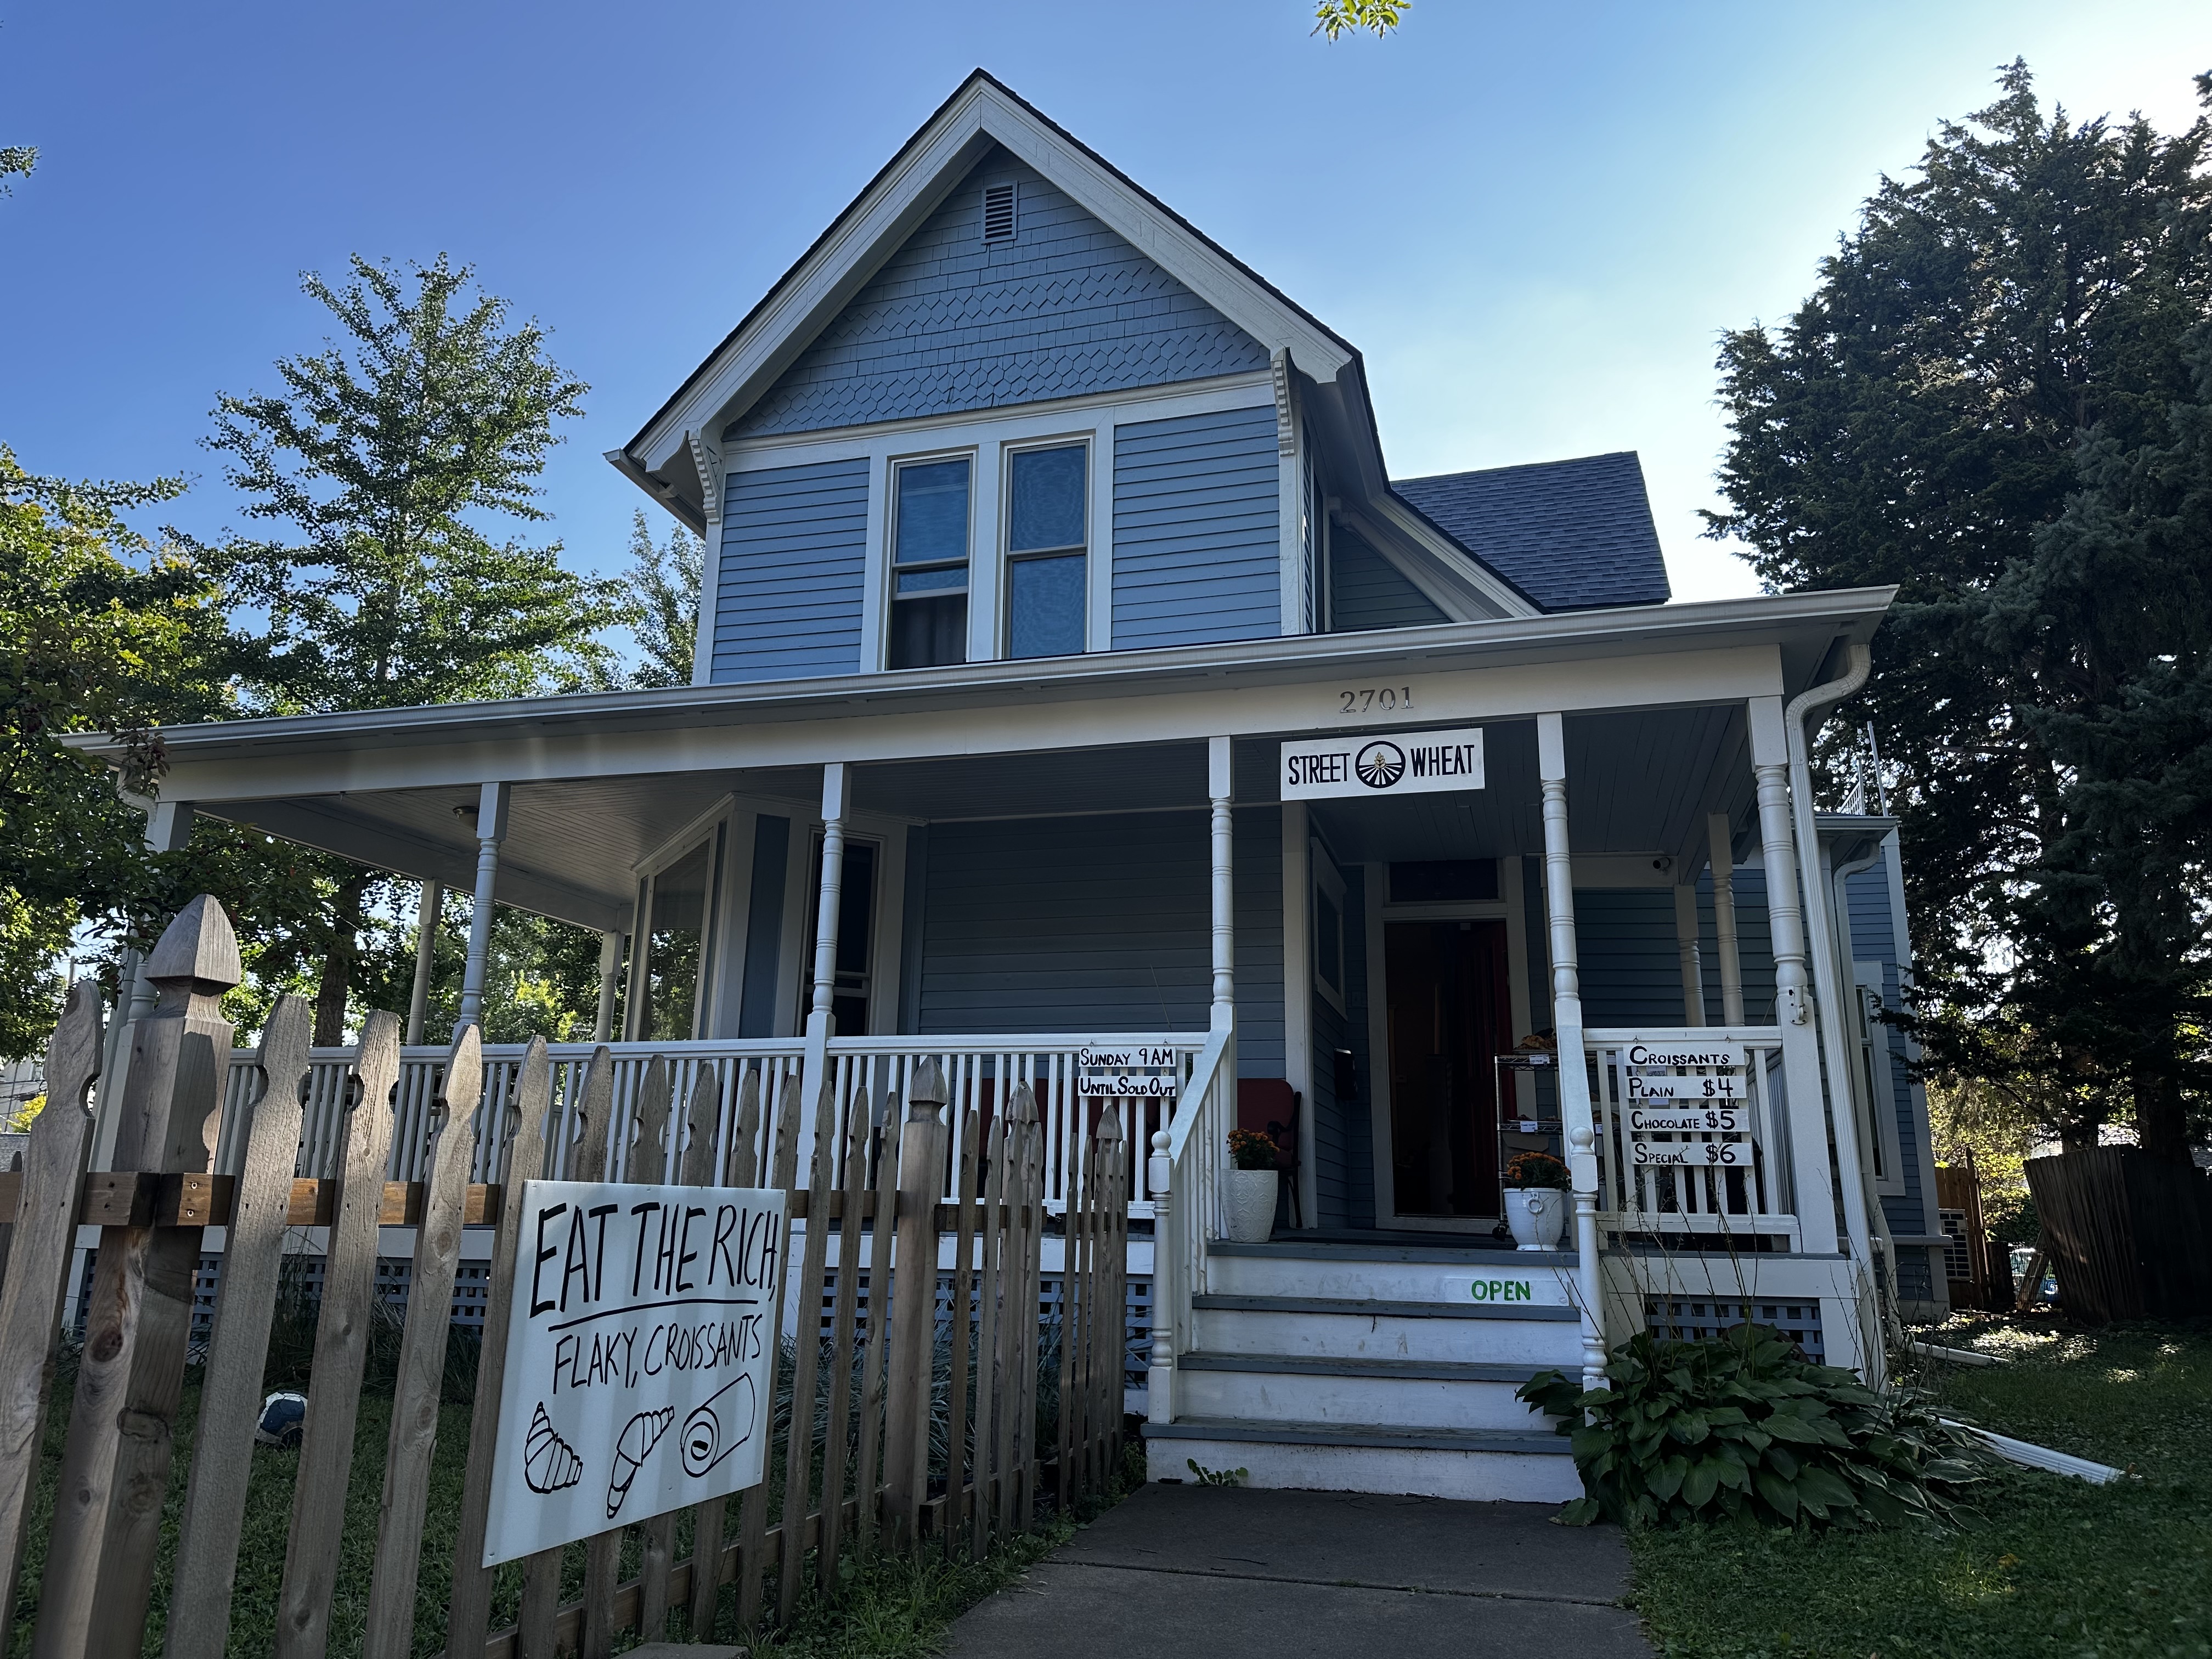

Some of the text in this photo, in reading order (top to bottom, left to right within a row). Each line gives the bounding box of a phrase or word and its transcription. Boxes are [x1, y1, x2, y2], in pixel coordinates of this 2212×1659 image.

[1339, 686, 1414, 713] 2701
[1288, 744, 1475, 785] STREET WHEAT
[1080, 1048, 1131, 1066] SUNDAY
[1629, 1046, 1730, 1066] CROISSANTS
[1080, 1076, 1175, 1097] UNTIL SOLD OUT
[1628, 1077, 1734, 1098] PLAIN $4
[1631, 1110, 1736, 1130] CHOCOLATE $5
[1634, 1142, 1736, 1164] SPECIAL $6
[529, 1203, 618, 1318] EAT
[631, 1202, 707, 1296] THE
[1471, 1280, 1531, 1301] OPEN
[644, 1313, 763, 1376] CROISSANTS
